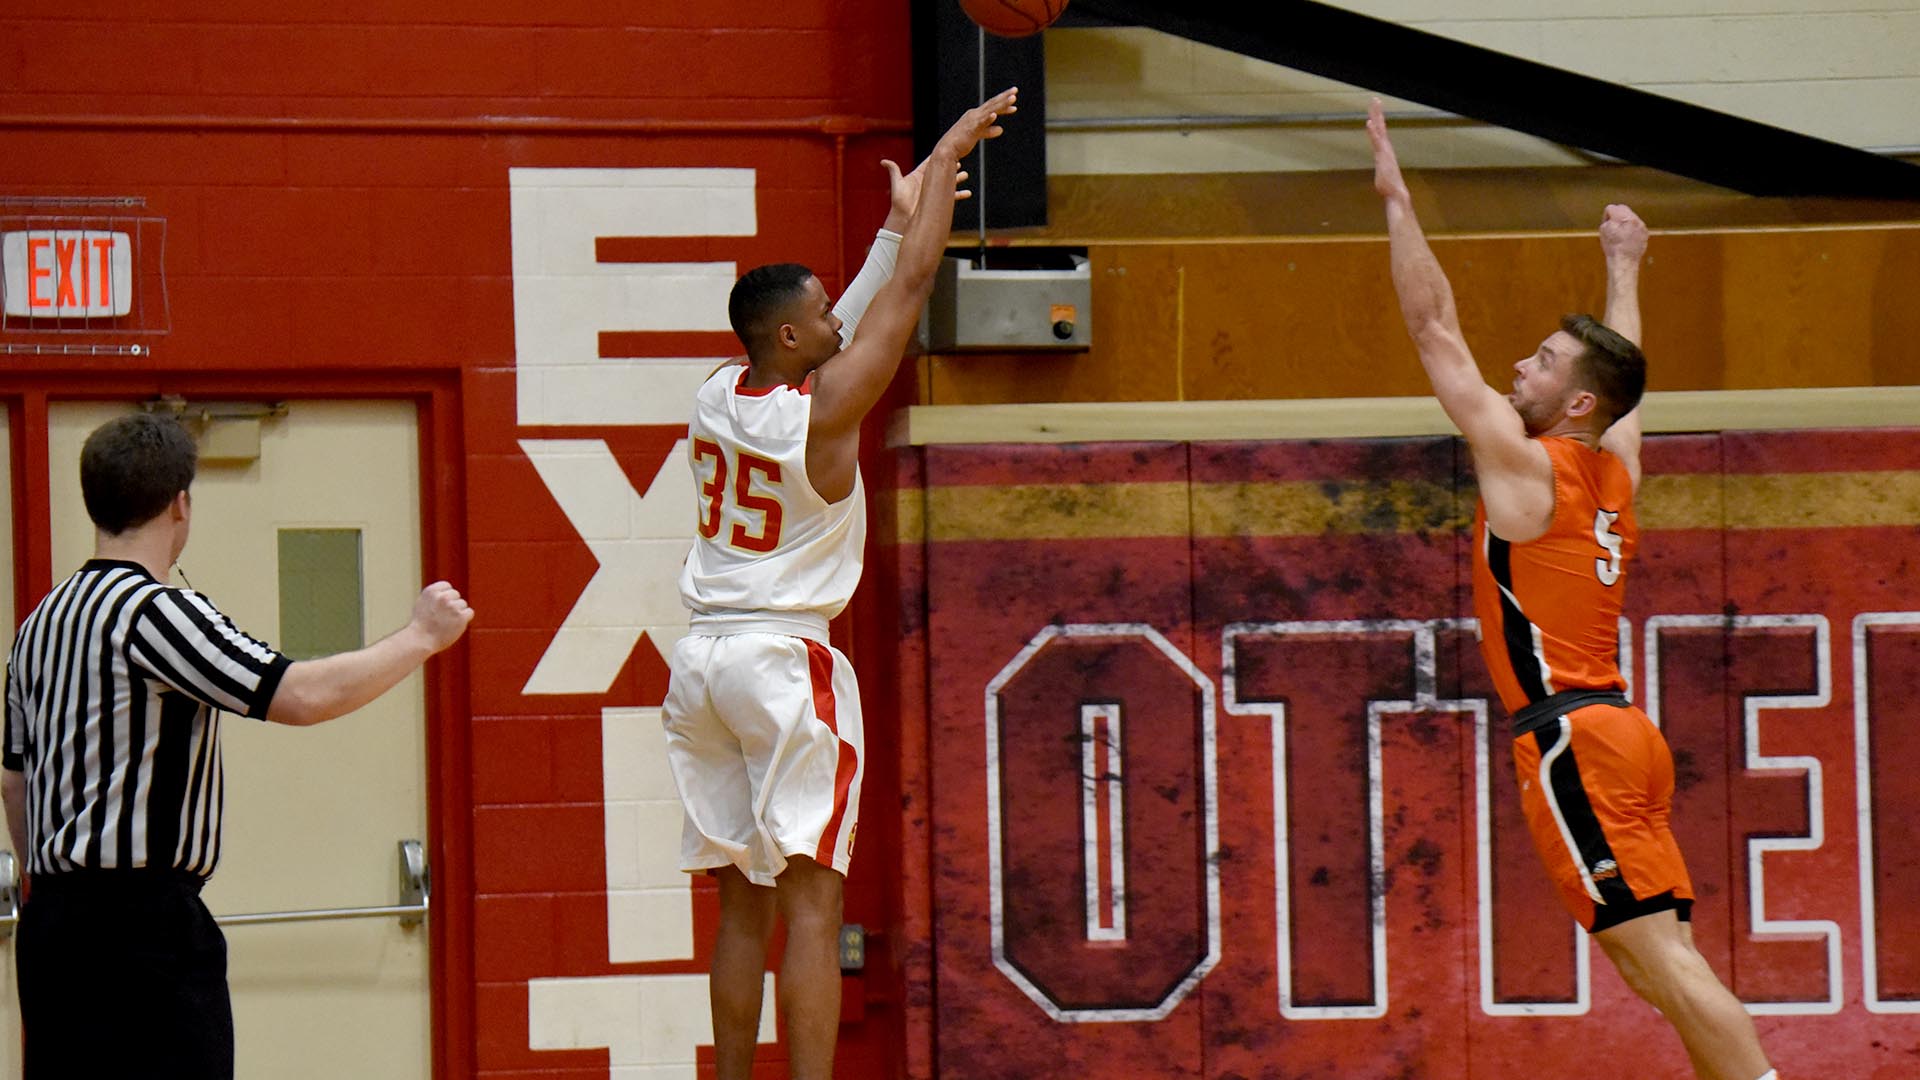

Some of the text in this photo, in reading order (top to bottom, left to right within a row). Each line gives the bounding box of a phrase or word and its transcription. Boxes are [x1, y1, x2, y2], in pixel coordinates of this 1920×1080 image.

[27, 238, 115, 307] EXIT
[693, 435, 784, 554] 35
[1594, 508, 1623, 586] 5
[985, 611, 1920, 1023] OTTE
